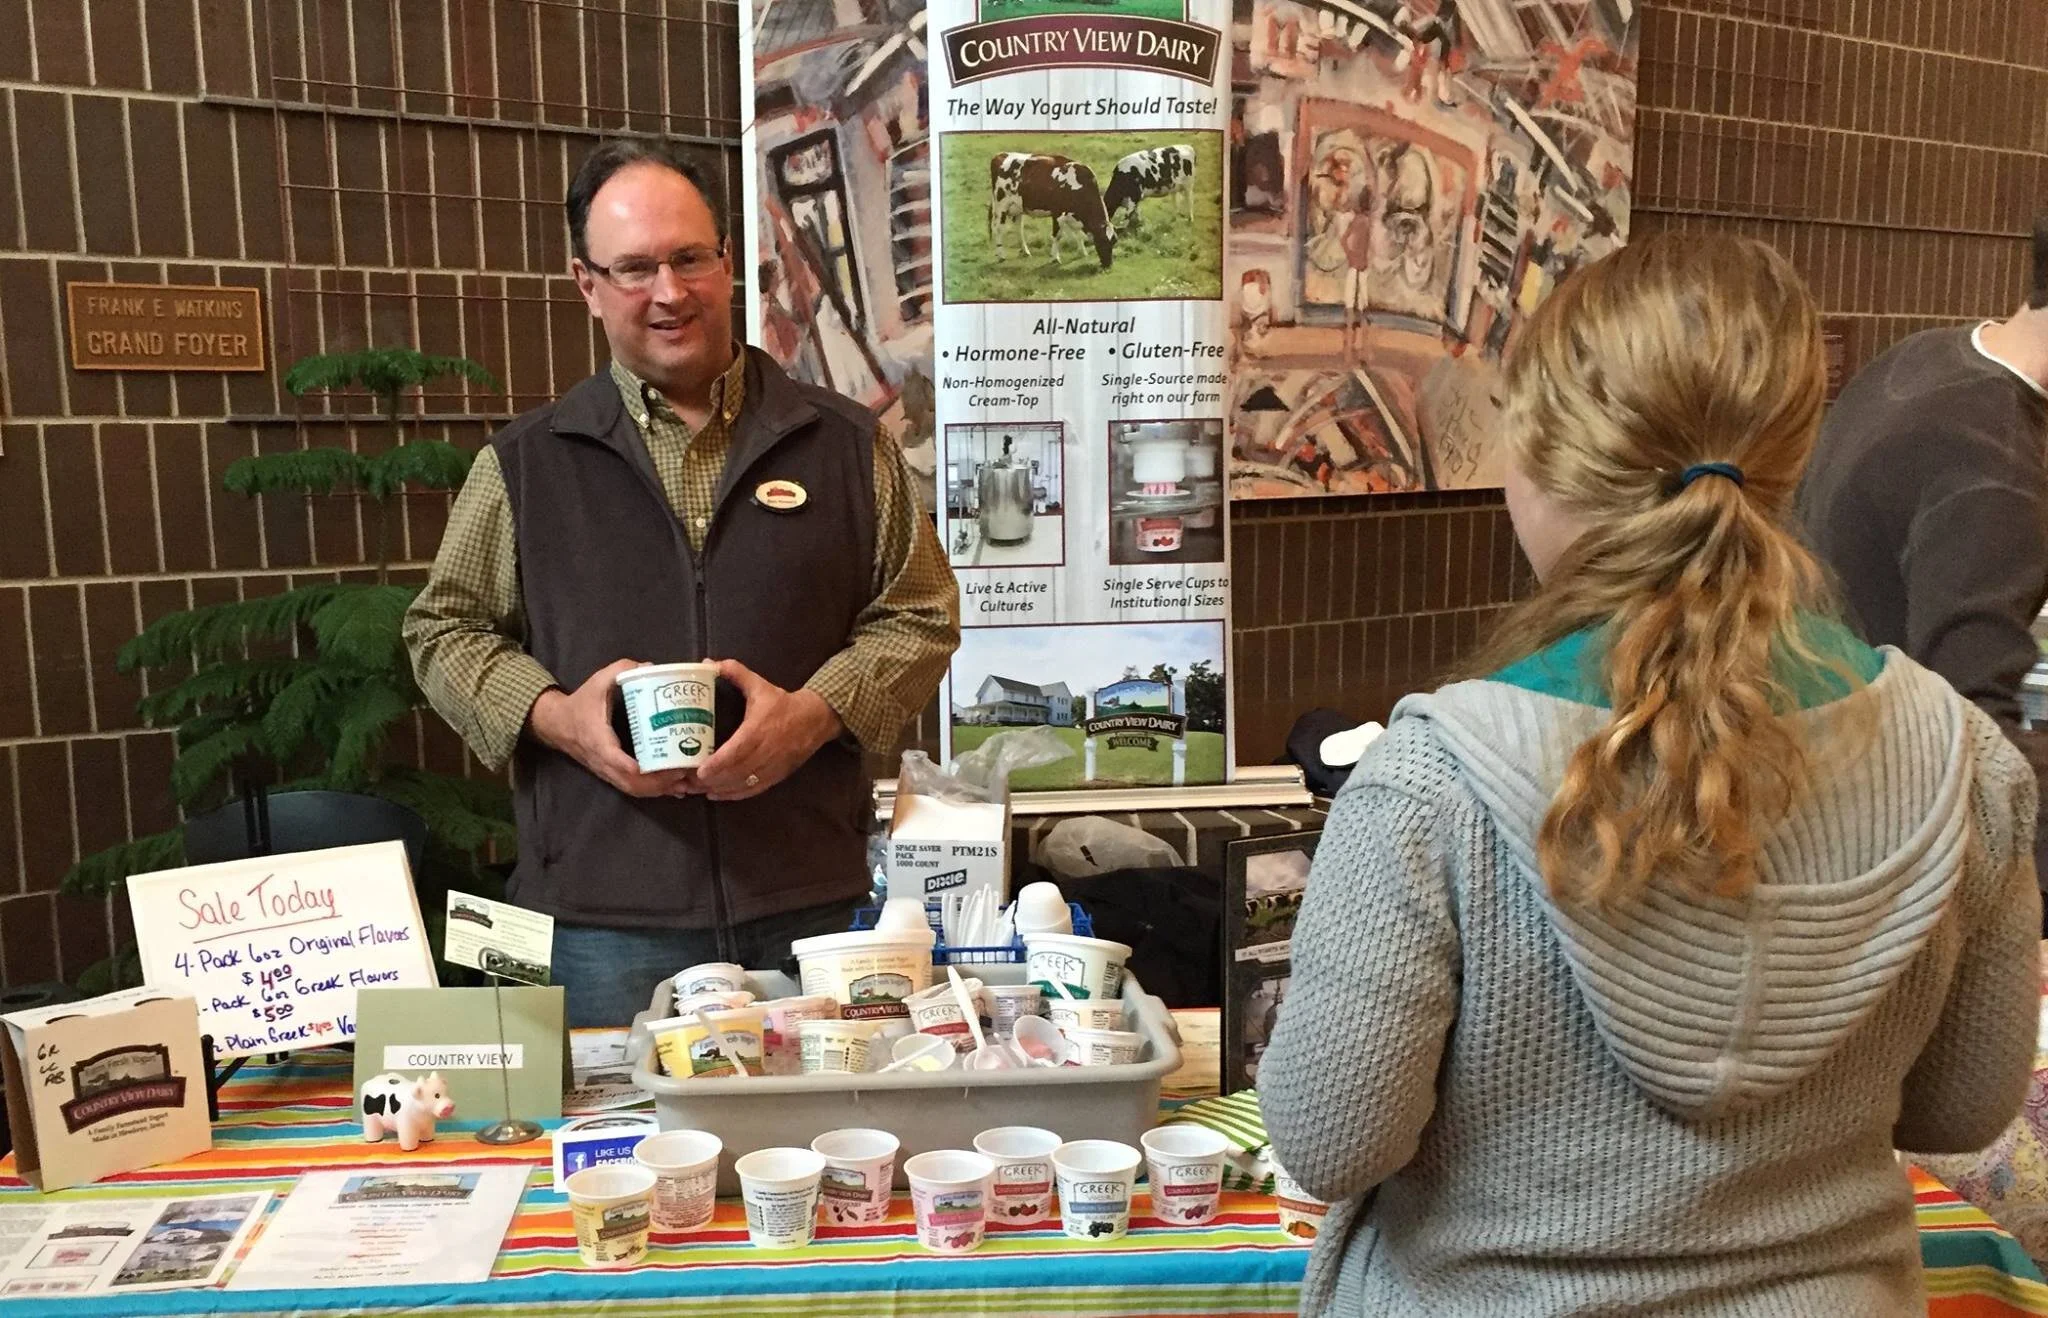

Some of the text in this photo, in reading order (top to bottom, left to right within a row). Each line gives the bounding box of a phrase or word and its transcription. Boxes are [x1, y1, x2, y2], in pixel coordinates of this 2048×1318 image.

[959, 27, 1206, 67] COUNTRY VIEW DAIRY
[947, 96, 1218, 120] The Way Yogurt Should Taste!
[87, 297, 145, 317] FRANK
[174, 300, 243, 319] WATKINS
[1033, 317, 1136, 335] All-Natural
[87, 331, 248, 357] GRAND FOYER
[1122, 341, 1225, 360] Gluten-Free
[955, 345, 1086, 362] Hormone-Free
[942, 374, 1065, 390] Non-Homogenized
[1101, 372, 1228, 388] Single-Source made
[968, 393, 1039, 409] Cream-Top
[1112, 391, 1221, 406] right on our farm
[965, 580, 1048, 595] Live & Active
[1103, 576, 1229, 593] Single Serve Cups to
[980, 600, 1034, 613] Cultures
[1110, 595, 1225, 610] Institutional Sizes
[662, 684, 707, 699] GREEK
[669, 727, 695, 736] PLAIN
[952, 846, 998, 857] PTM21S
[178, 873, 337, 930] Sale Today
[290, 930, 356, 955] Original
[359, 923, 410, 945] Flavors
[295, 974, 344, 996] Greek
[349, 968, 400, 987] Flavors
[923, 1008, 957, 1020] GREEK
[225, 1034, 267, 1051] Plain
[268, 1025, 310, 1043] Greek
[408, 1053, 513, 1066] COUNTRY VIEW
[595, 1146, 632, 1158] LIKE US
[1003, 1166, 1043, 1177] GREEK
[1176, 1166, 1213, 1177] GREEK
[1080, 1184, 1120, 1194] GREEK
